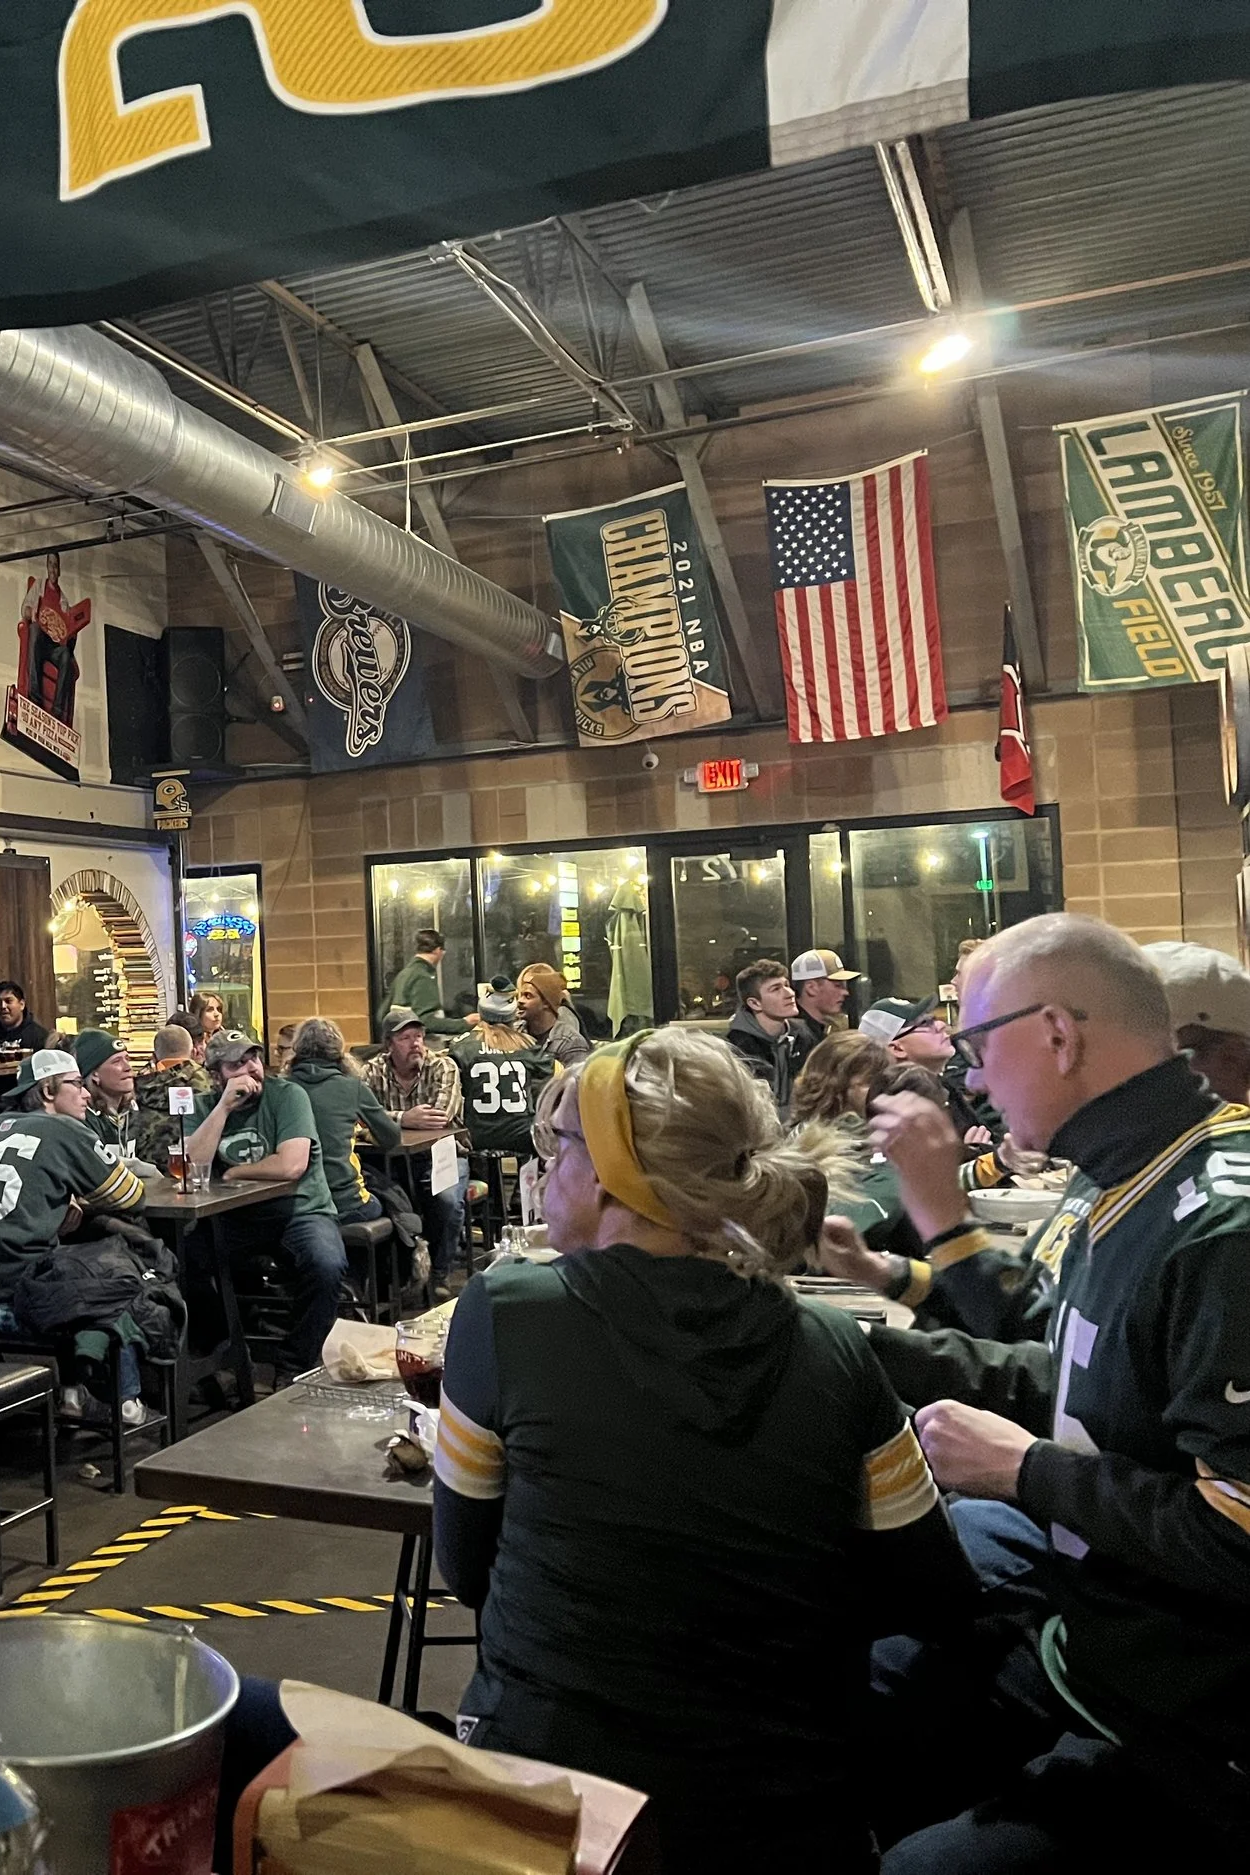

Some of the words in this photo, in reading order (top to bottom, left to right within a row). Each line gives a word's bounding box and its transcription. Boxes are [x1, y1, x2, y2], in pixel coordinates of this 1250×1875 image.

[1171, 425, 1199, 471] Since
[1193, 470, 1228, 511] 1957
[602, 509, 697, 724] CHAMPIONS
[673, 541, 696, 604] 2021
[685, 618, 710, 675] NBA
[1113, 598, 1185, 678] FIELD
[704, 759, 741, 788] EXIT
[470, 1061, 528, 1114] 33
